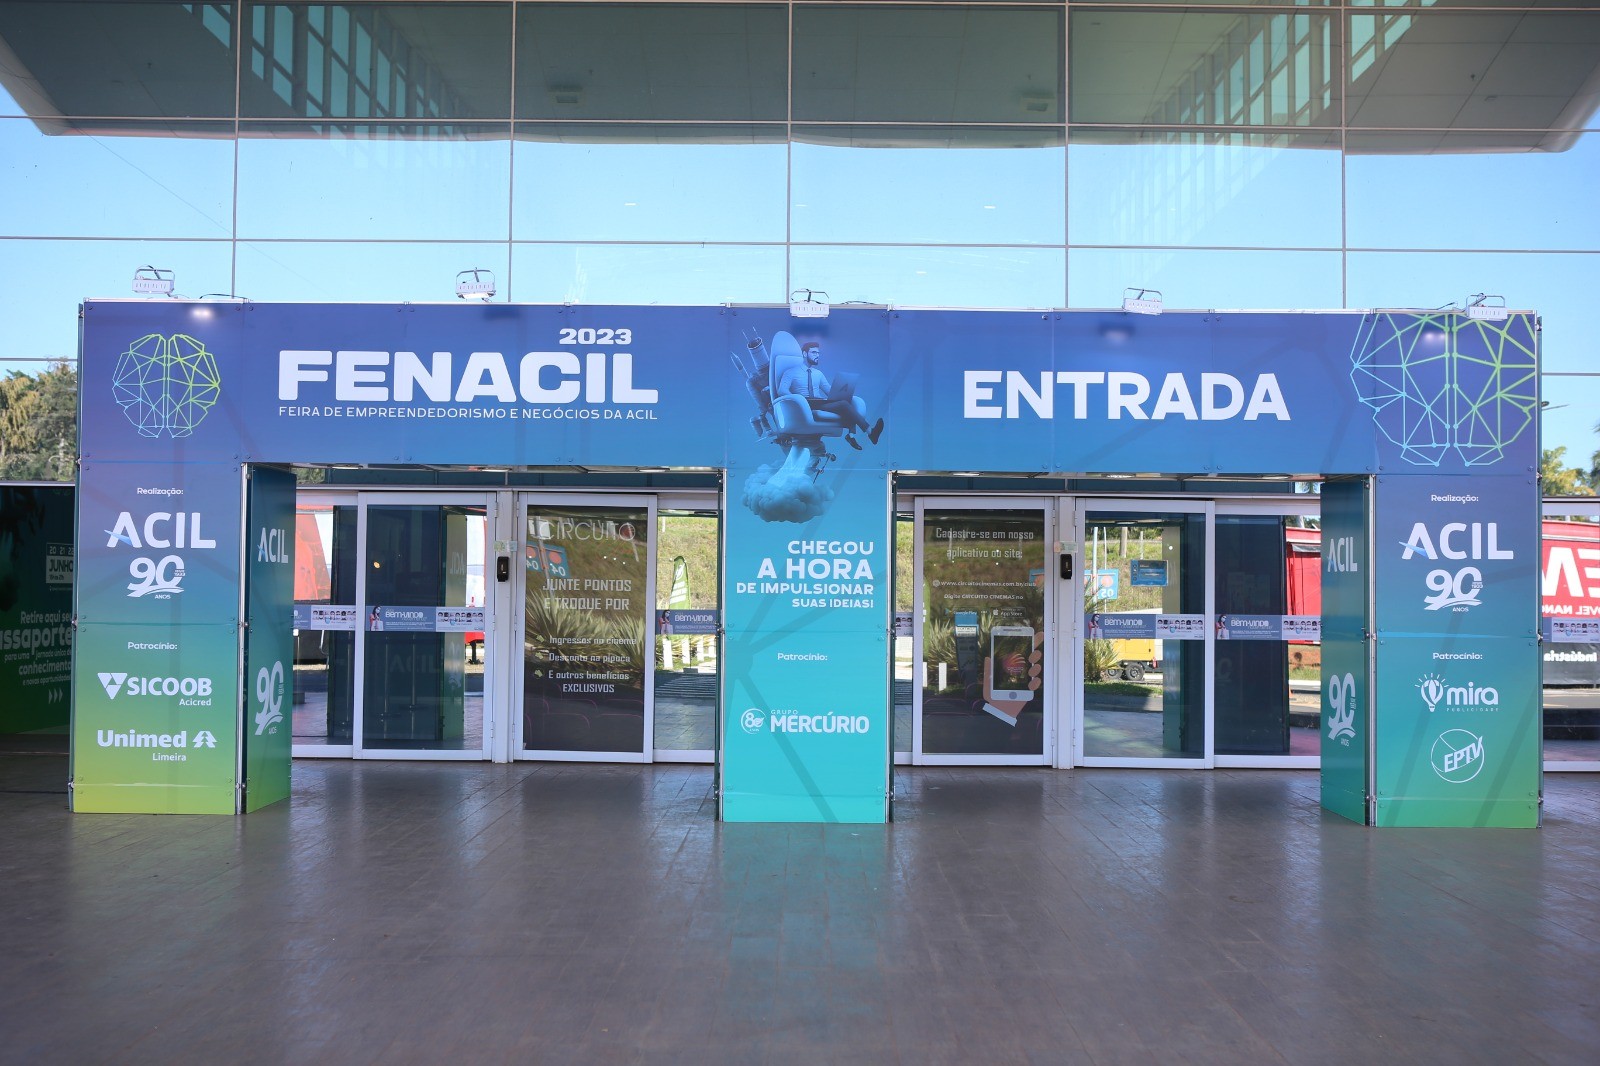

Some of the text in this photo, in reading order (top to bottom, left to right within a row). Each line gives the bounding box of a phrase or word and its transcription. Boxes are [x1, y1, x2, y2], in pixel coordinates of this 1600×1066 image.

[559, 328, 632, 345] 2023
[278, 350, 659, 404] FENACIL
[964, 370, 1291, 421] ENTRADA
[279, 406, 658, 420] FEIRA DE EMPREENDEDORISMO E NEGÓCIOS DA ACIL
[137, 486, 184, 498] Realização:
[1431, 494, 1479, 505] Realização:
[104, 512, 216, 548] ACIL
[540, 522, 636, 540] CIRCUITO
[936, 528, 990, 539] Cadastre-se
[257, 527, 288, 564] ACIL
[788, 540, 874, 555] CHEGOU
[1398, 522, 1514, 560] ACIL
[50, 546, 56, 554] 20
[946, 548, 988, 560] aplicativo
[1328, 536, 1358, 572] ACIL
[49, 558, 74, 572] JUNHO
[756, 558, 874, 580] A HORA
[127, 554, 184, 598] 90
[543, 579, 631, 591] JUNTE PONTOS
[736, 582, 874, 595] DE IMPULSIONAR
[1424, 566, 1482, 610] 90
[555, 598, 602, 610] TROQUE
[606, 598, 630, 610] POR
[792, 599, 874, 608] SUAS IDEIAS!
[20, 610, 43, 624] Retire
[45, 610, 60, 627] aqui
[128, 641, 178, 650] Patrocínio:
[548, 653, 588, 662] Desconto
[602, 654, 630, 664] pipoca
[777, 652, 828, 661] Patrocínio:
[1432, 652, 1483, 660] Patrocínio:
[548, 670, 629, 680] E outros benefícios
[127, 676, 212, 696] SICOOB
[562, 683, 615, 693] EXCLUSIVOS
[1446, 682, 1498, 705] mira
[179, 698, 212, 706] Acicred
[255, 660, 284, 735] 90
[1328, 672, 1356, 740] 90
[771, 711, 870, 734] MERCÚRIO
[97, 730, 187, 748] Unimed
[152, 752, 186, 762] Limeira
[1444, 736, 1483, 773] EPTV
